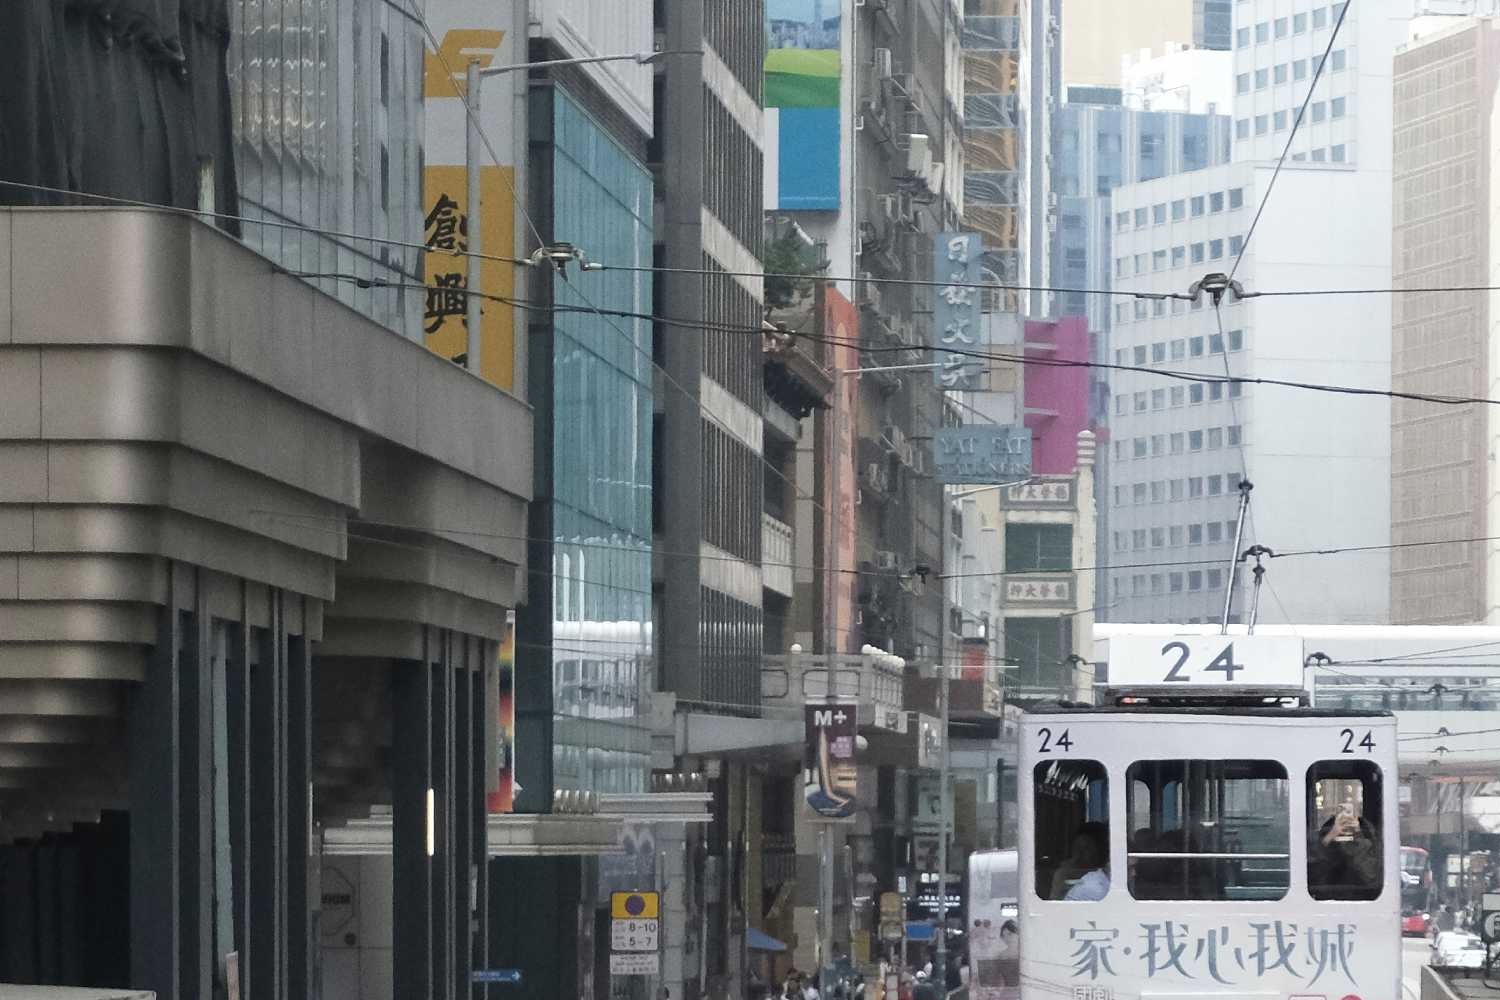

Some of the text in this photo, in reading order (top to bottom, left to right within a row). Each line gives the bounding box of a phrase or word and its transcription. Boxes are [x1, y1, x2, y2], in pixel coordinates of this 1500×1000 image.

[425, 193, 484, 369] 創興
[940, 437, 978, 455] YAT
[1161, 642, 1244, 682] 24
[814, 709, 848, 727] M+
[1037, 728, 1074, 752] 24
[1340, 729, 1376, 753] 24
